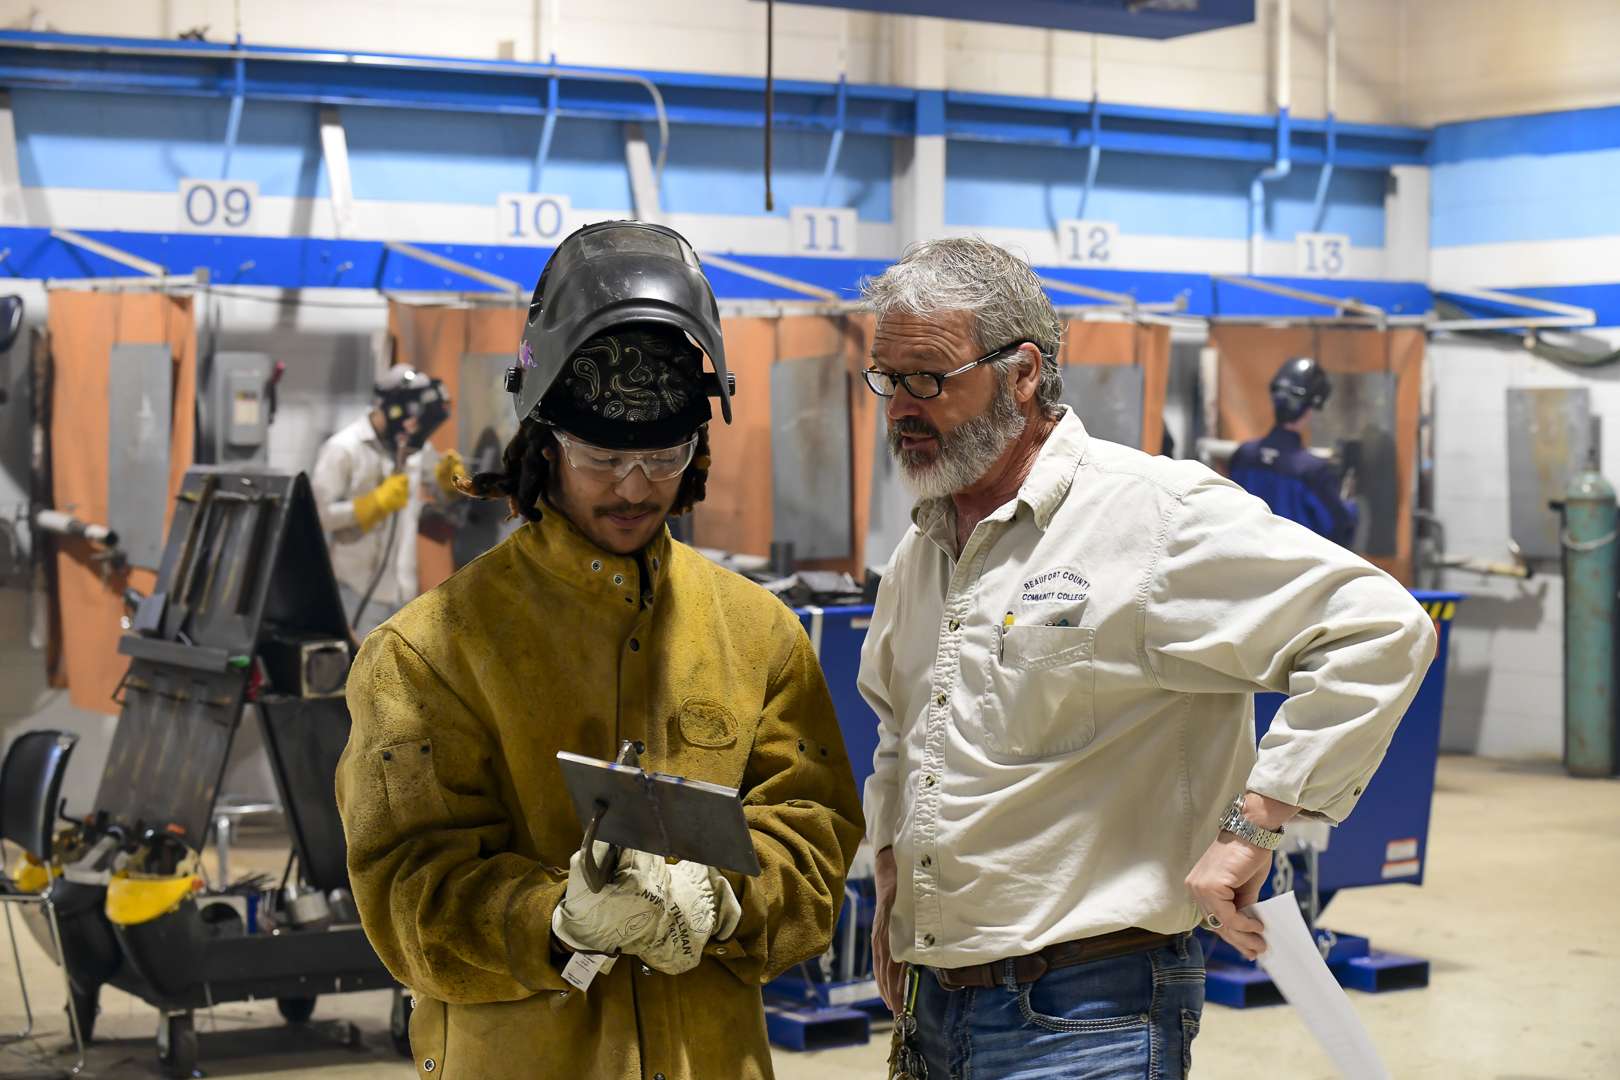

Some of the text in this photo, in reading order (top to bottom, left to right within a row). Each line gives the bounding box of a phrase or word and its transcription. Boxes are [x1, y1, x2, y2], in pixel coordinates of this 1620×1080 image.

[185, 185, 251, 228] 09
[508, 199, 563, 239] 10
[801, 213, 846, 252] 11
[1067, 226, 1110, 262] 12
[1304, 240, 1344, 274] 13
[1023, 571, 1091, 591] BEAUFORT COUNTY
[1056, 592, 1087, 601] COLLEGE
[670, 902, 692, 955] TILLMAN
